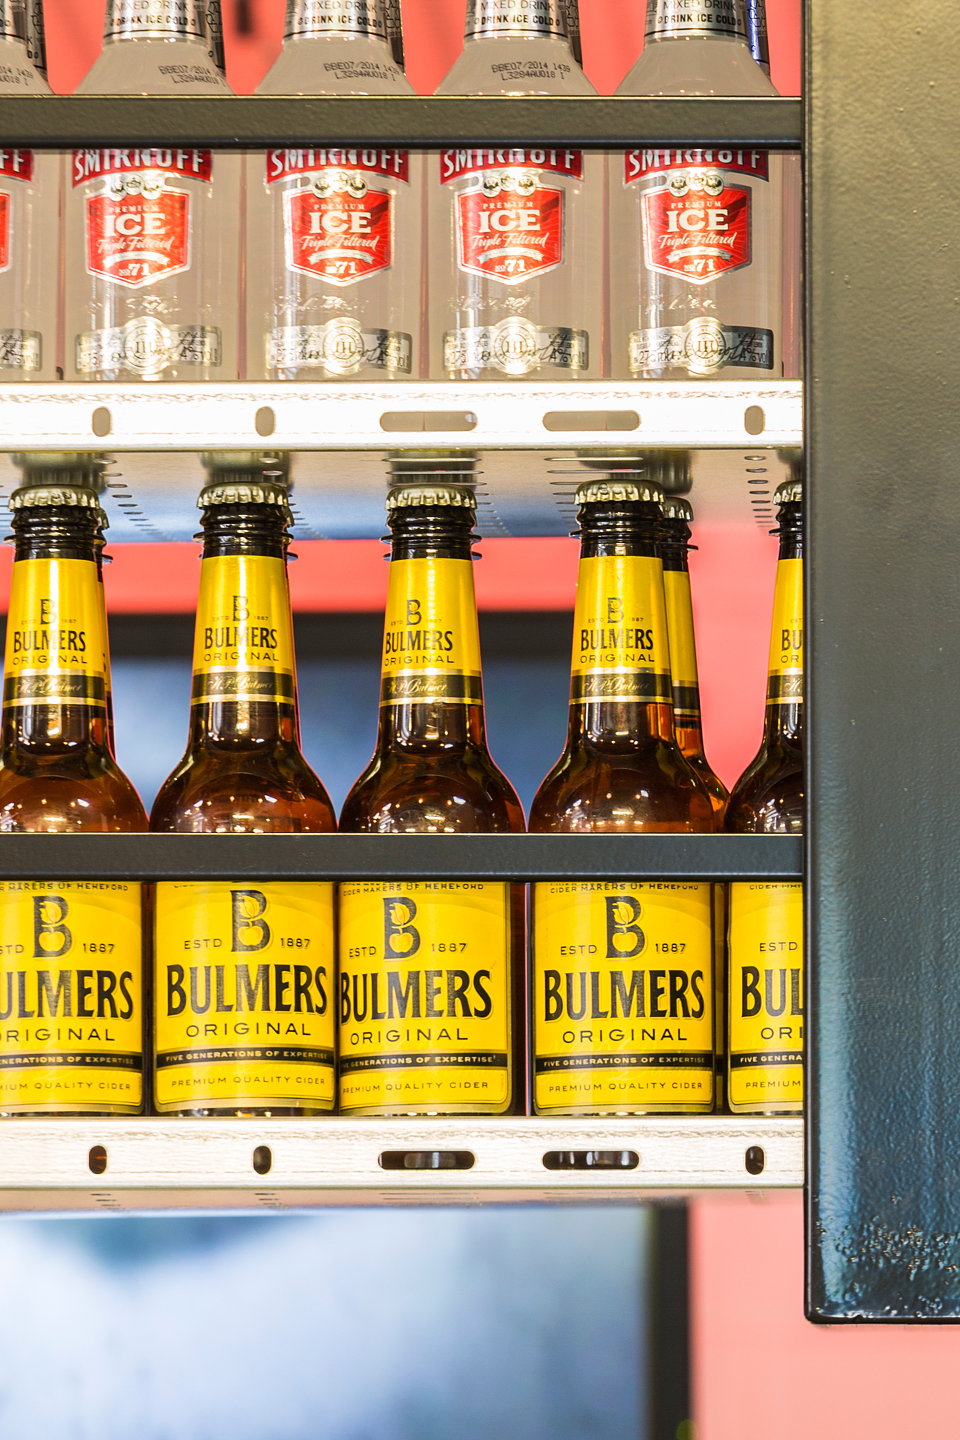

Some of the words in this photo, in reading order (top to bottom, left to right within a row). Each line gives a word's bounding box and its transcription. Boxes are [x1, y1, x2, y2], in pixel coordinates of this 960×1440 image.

[520, 0, 555, 12] DRINK
[704, 0, 737, 11] DRINK
[337, 15, 353, 24] ICE
[512, 15, 529, 24] ICE
[532, 16, 554, 26] COLD
[664, 14, 693, 25] DRINK
[697, 14, 713, 24] ICE
[717, 15, 738, 26] COLD
[313, 202, 365, 211] PREMIUM
[482, 200, 534, 210] PREMIUM
[671, 200, 722, 209] PREMIUM
[104, 212, 166, 237] ICE
[309, 210, 372, 234] ICE
[478, 208, 540, 233] ICE
[666, 208, 729, 233] ICE
[300, 235, 332, 252] Triple
[333, 234, 380, 251] Filtered
[471, 233, 501, 250] Triple
[503, 231, 550, 248] Filtered
[658, 233, 689, 249] Triple
[691, 231, 738, 248] Filtered
[406, 599, 422, 626] B
[607, 597, 624, 623] B
[386, 629, 453, 654] BULMERS
[581, 628, 653, 652] BULMERS
[384, 655, 455, 666] ORIGINAL
[580, 653, 655, 663] ORIGINAL
[32, 896, 72, 958] B
[231, 889, 271, 952] B
[605, 895, 645, 958] B
[383, 896, 421, 959] B
[0, 945, 24, 955] STD
[82, 943, 115, 954] 1887
[184, 938, 222, 950] ESTD
[280, 938, 311, 949] 1887
[349, 946, 376, 958] ESTD
[431, 943, 467, 952] 1887
[560, 945, 598, 955] ESTD
[655, 943, 687, 953] 1887
[759, 942, 798, 952] ESTD
[0, 970, 134, 1020] ULMERS
[166, 964, 328, 1016] BULMERS
[341, 969, 493, 1024] BULMERS
[544, 969, 705, 1021] BULMERS
[0, 1028, 116, 1042] RIGINAL
[186, 1023, 312, 1037] ORIGINAL
[350, 1028, 469, 1045] ORIGINAL
[563, 1028, 688, 1043] ORIGINAL
[86, 1057, 134, 1065] EXPERTISE
[166, 1054, 183, 1062] FIVE
[186, 1050, 262, 1060] GENERATIONS
[266, 1050, 279, 1058] OF
[284, 1051, 327, 1059] EXPERTISE
[351, 1057, 412, 1068] GENERATIONS
[563, 1057, 637, 1066] GENERATIONS
[761, 1054, 803, 1062] GENERA
[34, 1081, 92, 1090] QUALITY
[99, 1082, 130, 1090] CIDER
[172, 1077, 226, 1087] PREMIUM
[233, 1075, 290, 1084] QUALITY
[296, 1076, 325, 1085] CIDER
[343, 1085, 380, 1094] PREMIUM
[386, 1082, 443, 1091] QUALITY
[450, 1081, 488, 1089] CIDER
[549, 1083, 602, 1092] PREMIUM
[609, 1082, 666, 1090] QUALITY
[746, 1080, 801, 1088] PREMIUM
